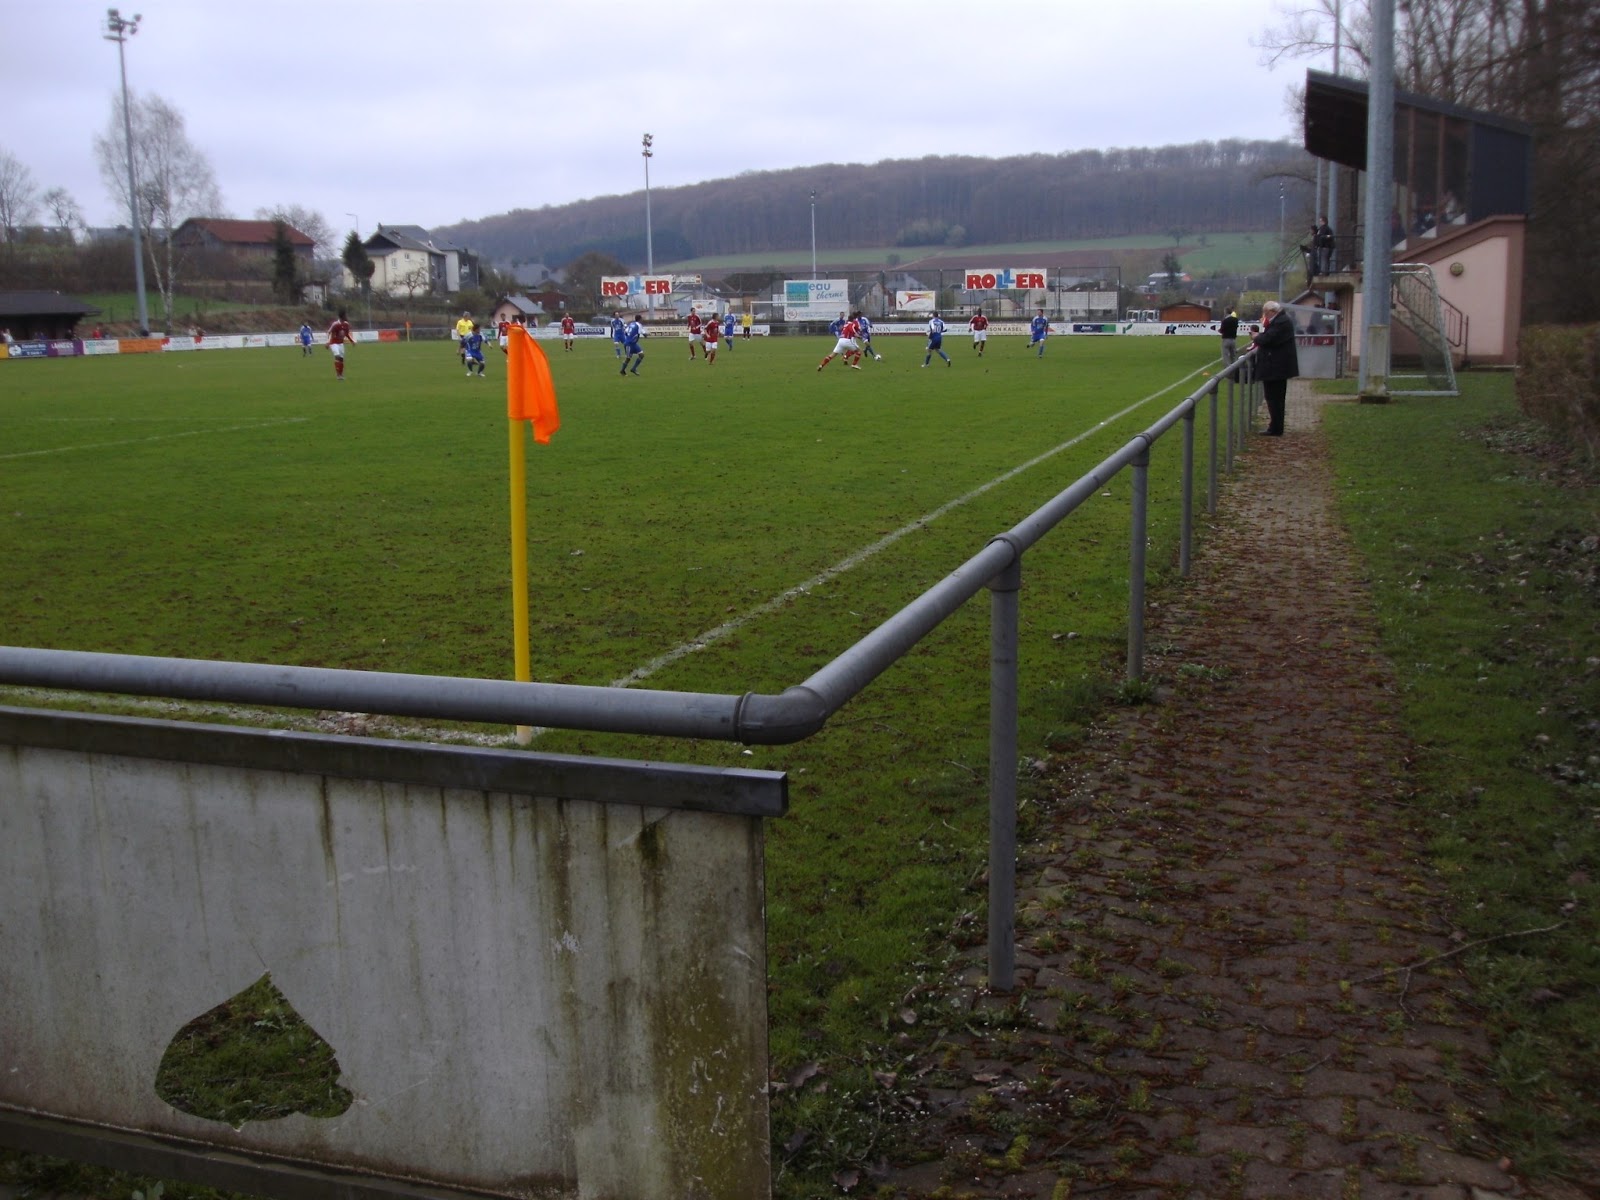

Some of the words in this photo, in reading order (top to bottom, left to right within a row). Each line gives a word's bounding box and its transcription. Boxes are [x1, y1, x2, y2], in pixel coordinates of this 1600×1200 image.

[602, 275, 670, 295] ROLLER
[808, 283, 832, 292] eau
[966, 268, 1046, 289] ROLLER
